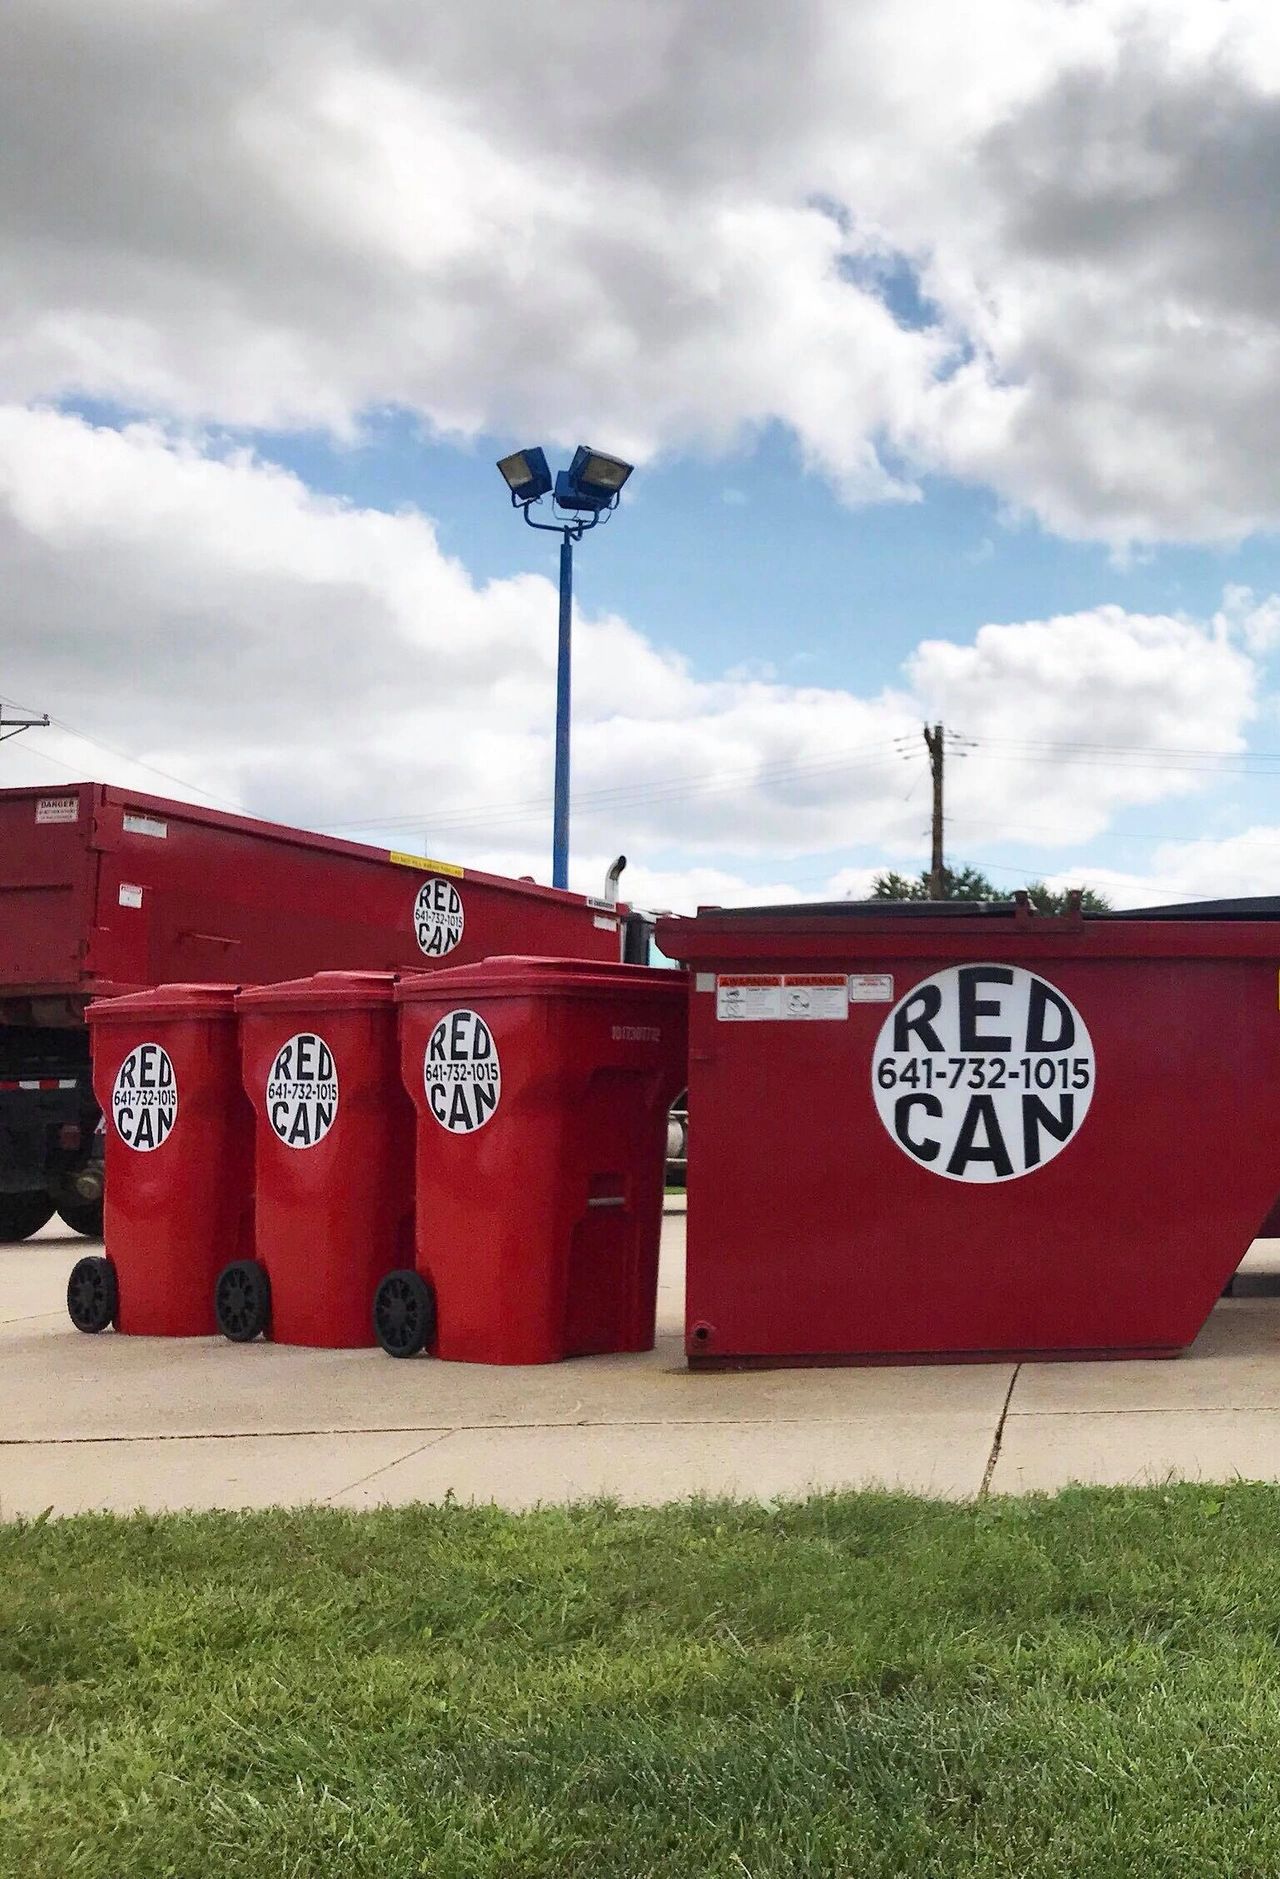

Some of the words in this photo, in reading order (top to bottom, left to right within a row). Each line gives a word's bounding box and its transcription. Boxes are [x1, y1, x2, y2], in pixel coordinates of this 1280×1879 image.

[420, 881, 460, 913] RED
[415, 909, 463, 928] 641-732-1015
[419, 923, 459, 954] CAN
[893, 966, 1075, 1053] RED
[430, 1012, 491, 1060] RED
[120, 1046, 172, 1088] RED
[275, 1036, 333, 1080] RED
[426, 1063, 499, 1081] 641-732-1015
[878, 1057, 1090, 1090] 641-732-1015
[115, 1090, 176, 1106] 641-732-1015
[269, 1083, 337, 1100] 641-732-1015
[431, 1083, 496, 1130] CAN
[118, 1107, 173, 1148] CAN
[273, 1101, 333, 1145] CAN
[894, 1092, 1074, 1177] CAN
